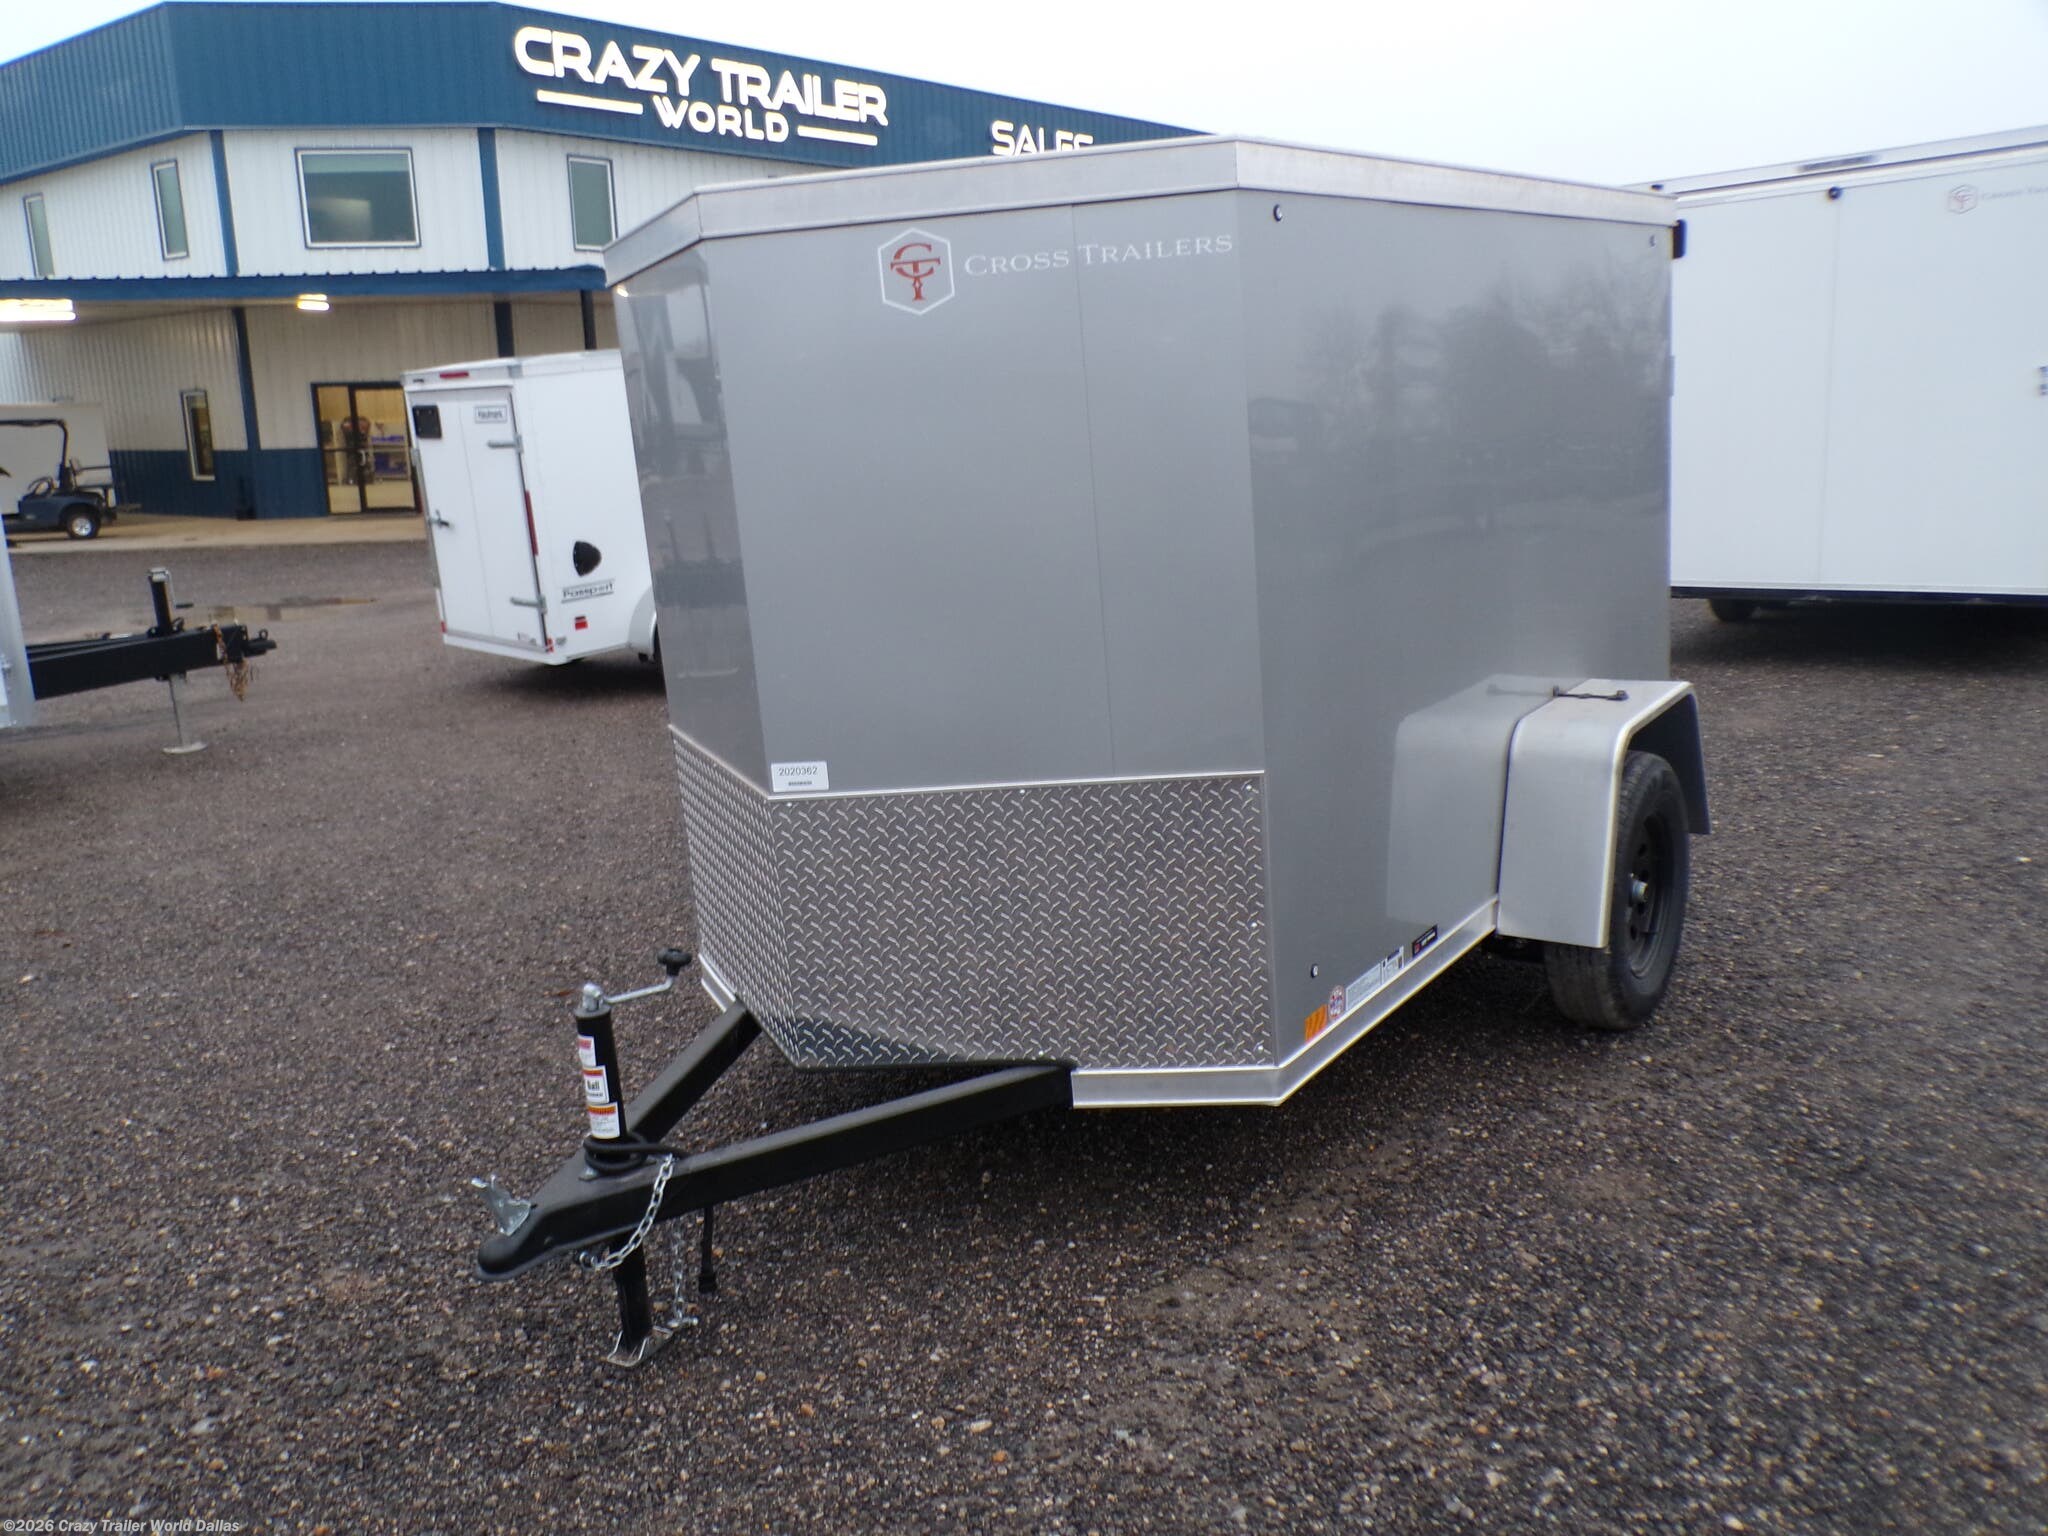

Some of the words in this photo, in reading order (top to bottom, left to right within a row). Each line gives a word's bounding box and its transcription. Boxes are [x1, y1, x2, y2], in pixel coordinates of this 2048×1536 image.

[513, 25, 701, 97] CRAZY
[710, 57, 889, 127] TRAILER
[653, 95, 790, 143] WORLD
[963, 250, 1070, 276] CROSS
[1077, 234, 1234, 266] TRAILERS
